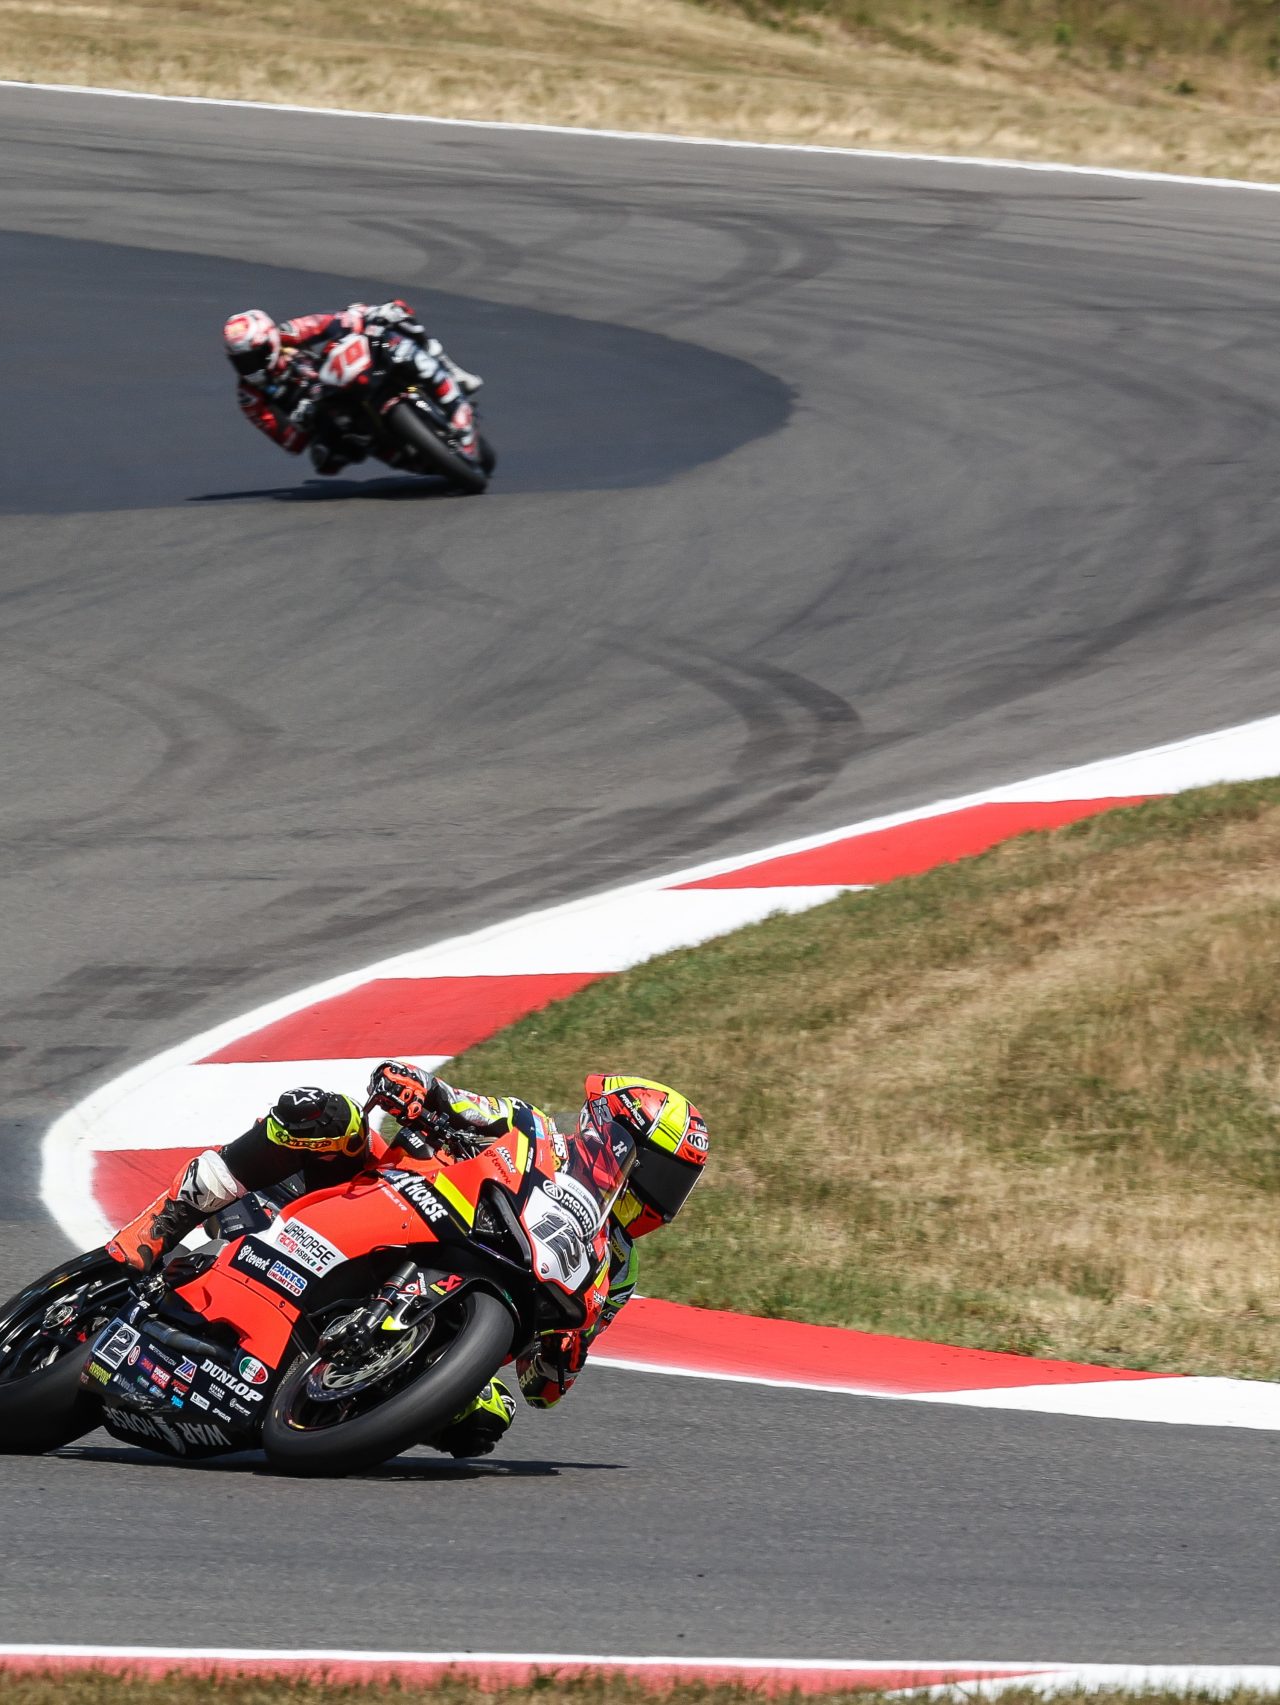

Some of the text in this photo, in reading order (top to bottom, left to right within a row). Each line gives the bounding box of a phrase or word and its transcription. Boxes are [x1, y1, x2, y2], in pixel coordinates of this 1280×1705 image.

[400, 1128, 425, 1151] DUCATI
[408, 1179, 449, 1224] HORSE
[563, 1193, 593, 1231] MOUNT
[278, 1232, 312, 1266] racing HSBK
[283, 1221, 336, 1266] WARHORSE
[529, 1211, 582, 1283] 12
[245, 1250, 271, 1272] tevent
[272, 1260, 307, 1290] PARTS
[267, 1270, 302, 1296] UNLIMITED
[199, 1358, 264, 1403] DUNLOP
[176, 1421, 232, 1447] WAR
